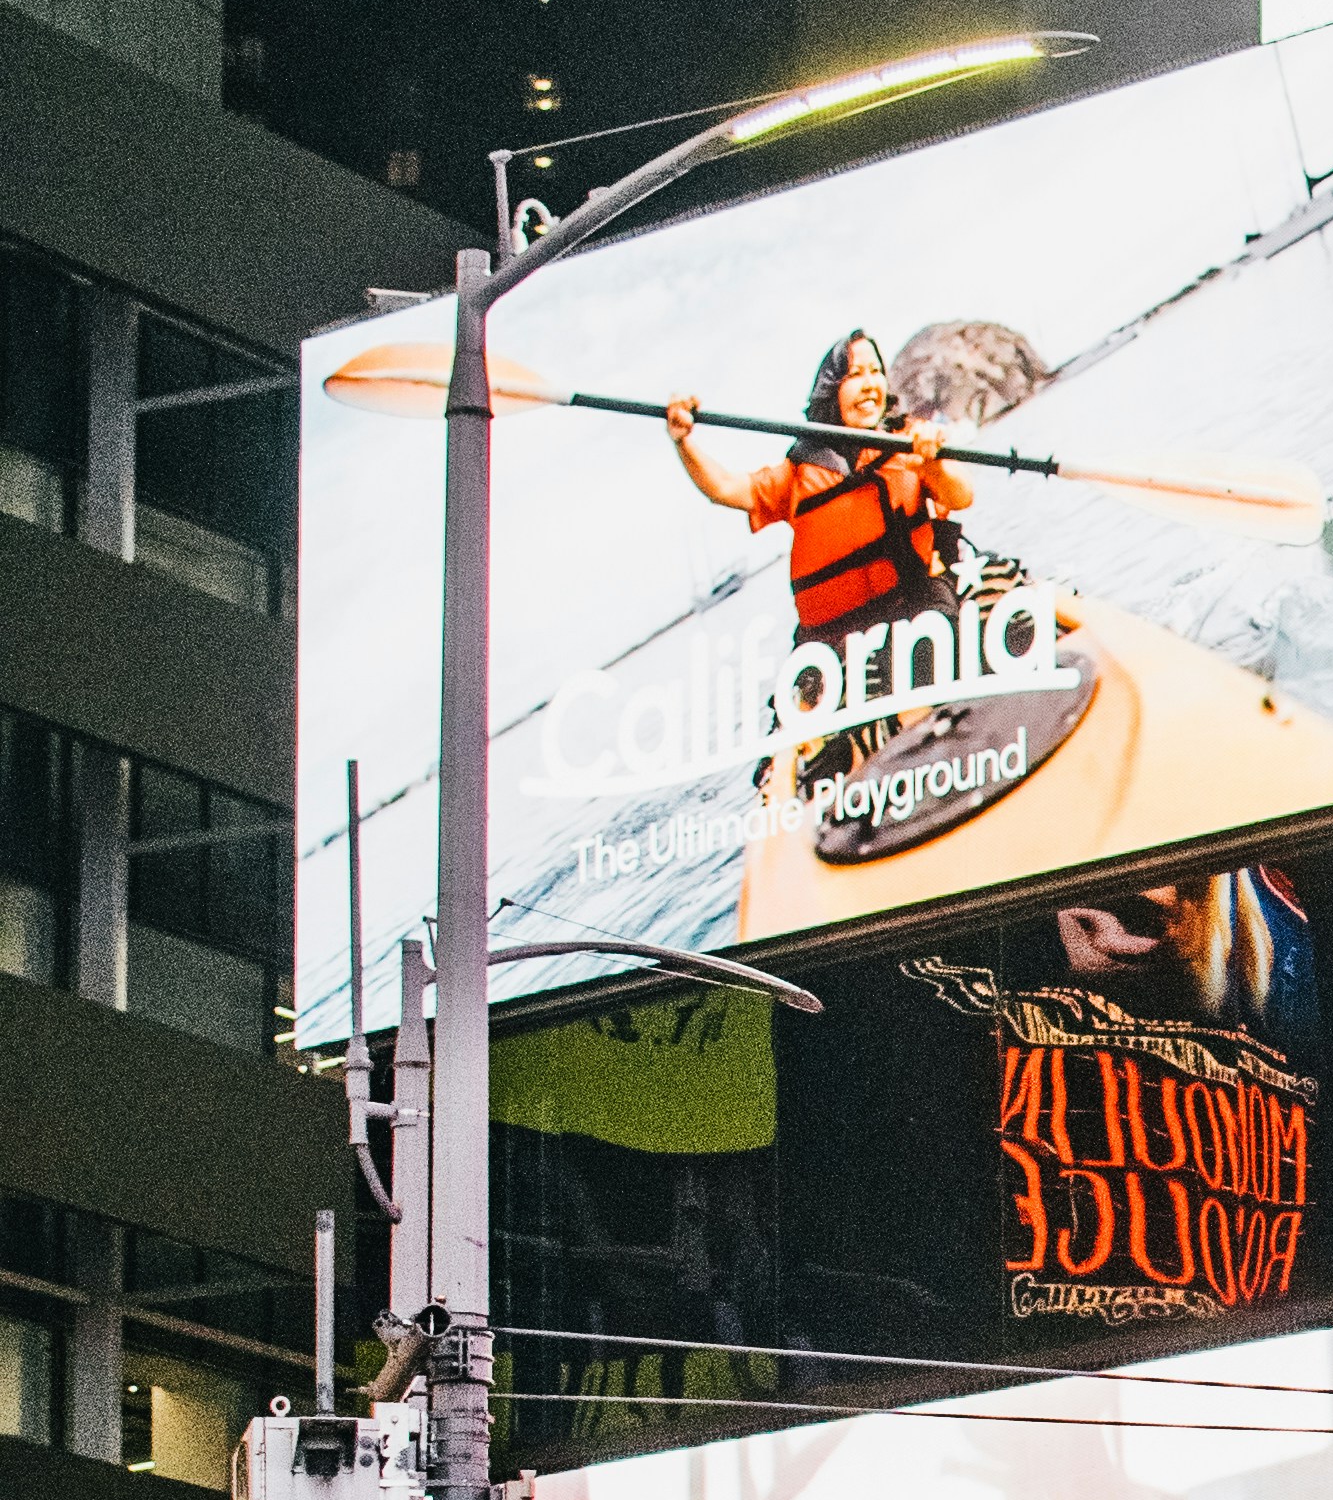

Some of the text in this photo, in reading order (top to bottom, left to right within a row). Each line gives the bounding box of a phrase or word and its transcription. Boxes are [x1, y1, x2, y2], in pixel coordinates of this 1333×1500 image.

[538, 550, 1060, 784] California
[570, 728, 1029, 885] The Ultimate Playground
